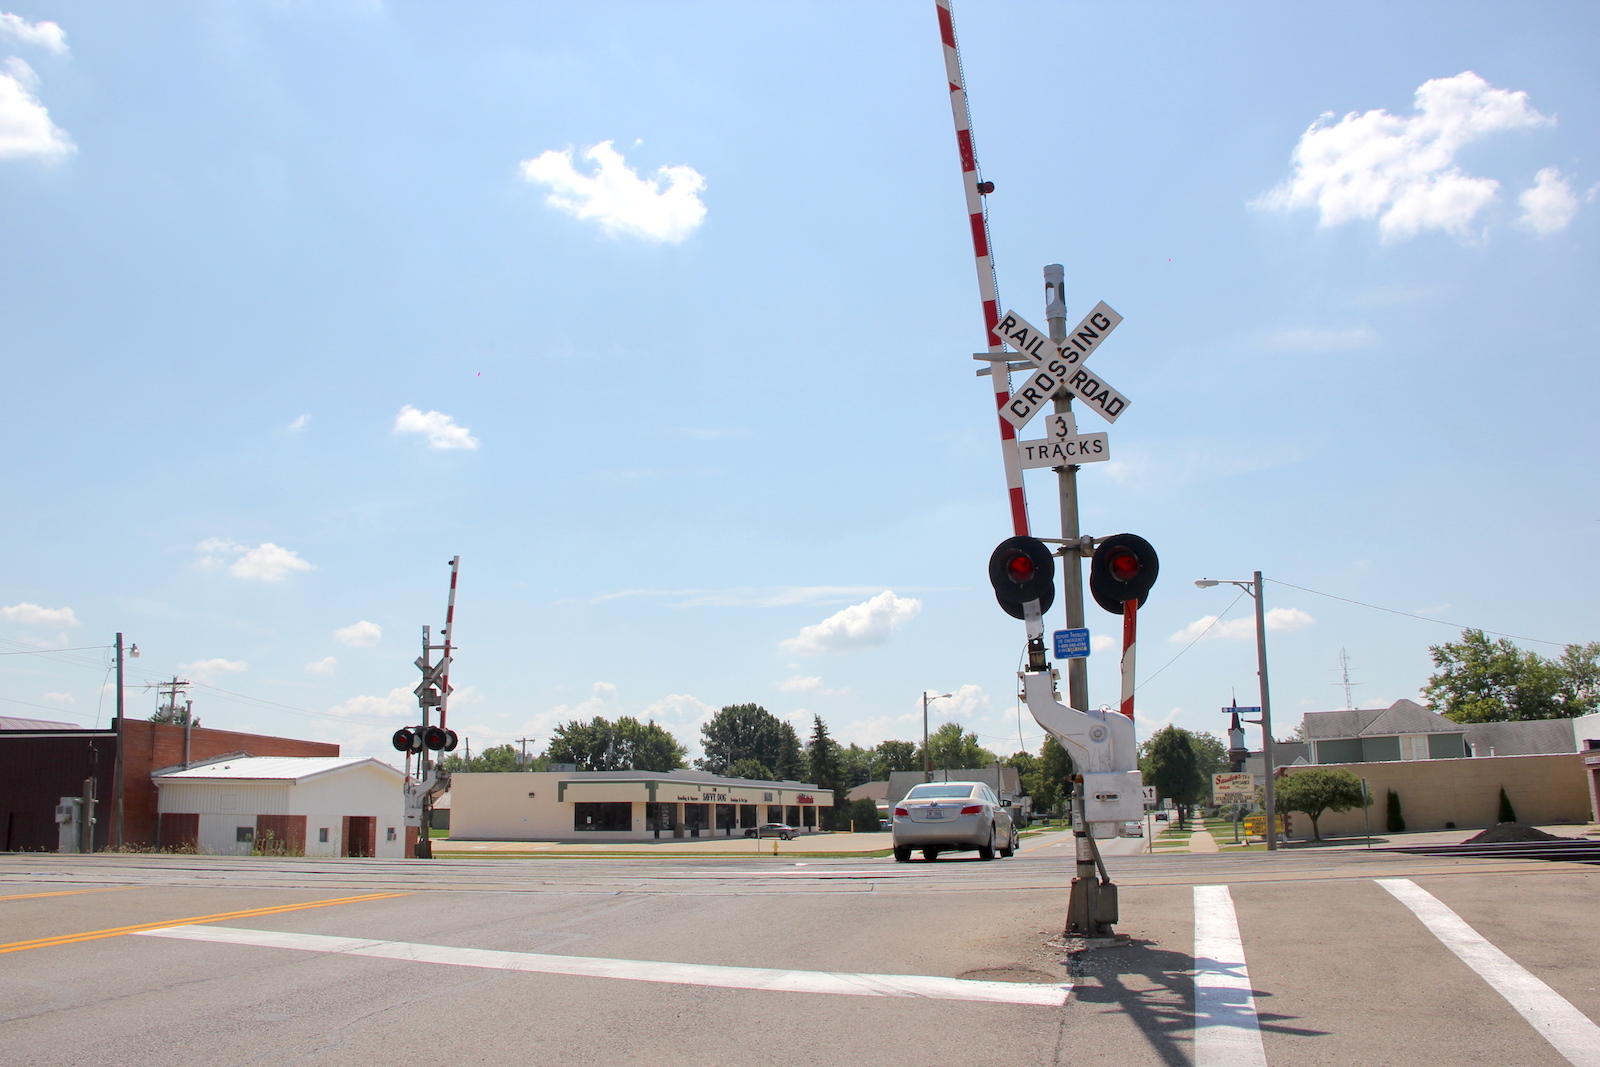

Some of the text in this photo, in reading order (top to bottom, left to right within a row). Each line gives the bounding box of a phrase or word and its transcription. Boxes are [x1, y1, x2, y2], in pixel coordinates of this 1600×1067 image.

[998, 315, 1125, 417] RAIL ROAD
[1010, 312, 1111, 418] CROSSING
[1055, 416, 1068, 438] 3
[1025, 439, 1103, 460] TRACKS
[702, 792, 716, 802] SAVVY
[717, 793, 727, 802] DOG
